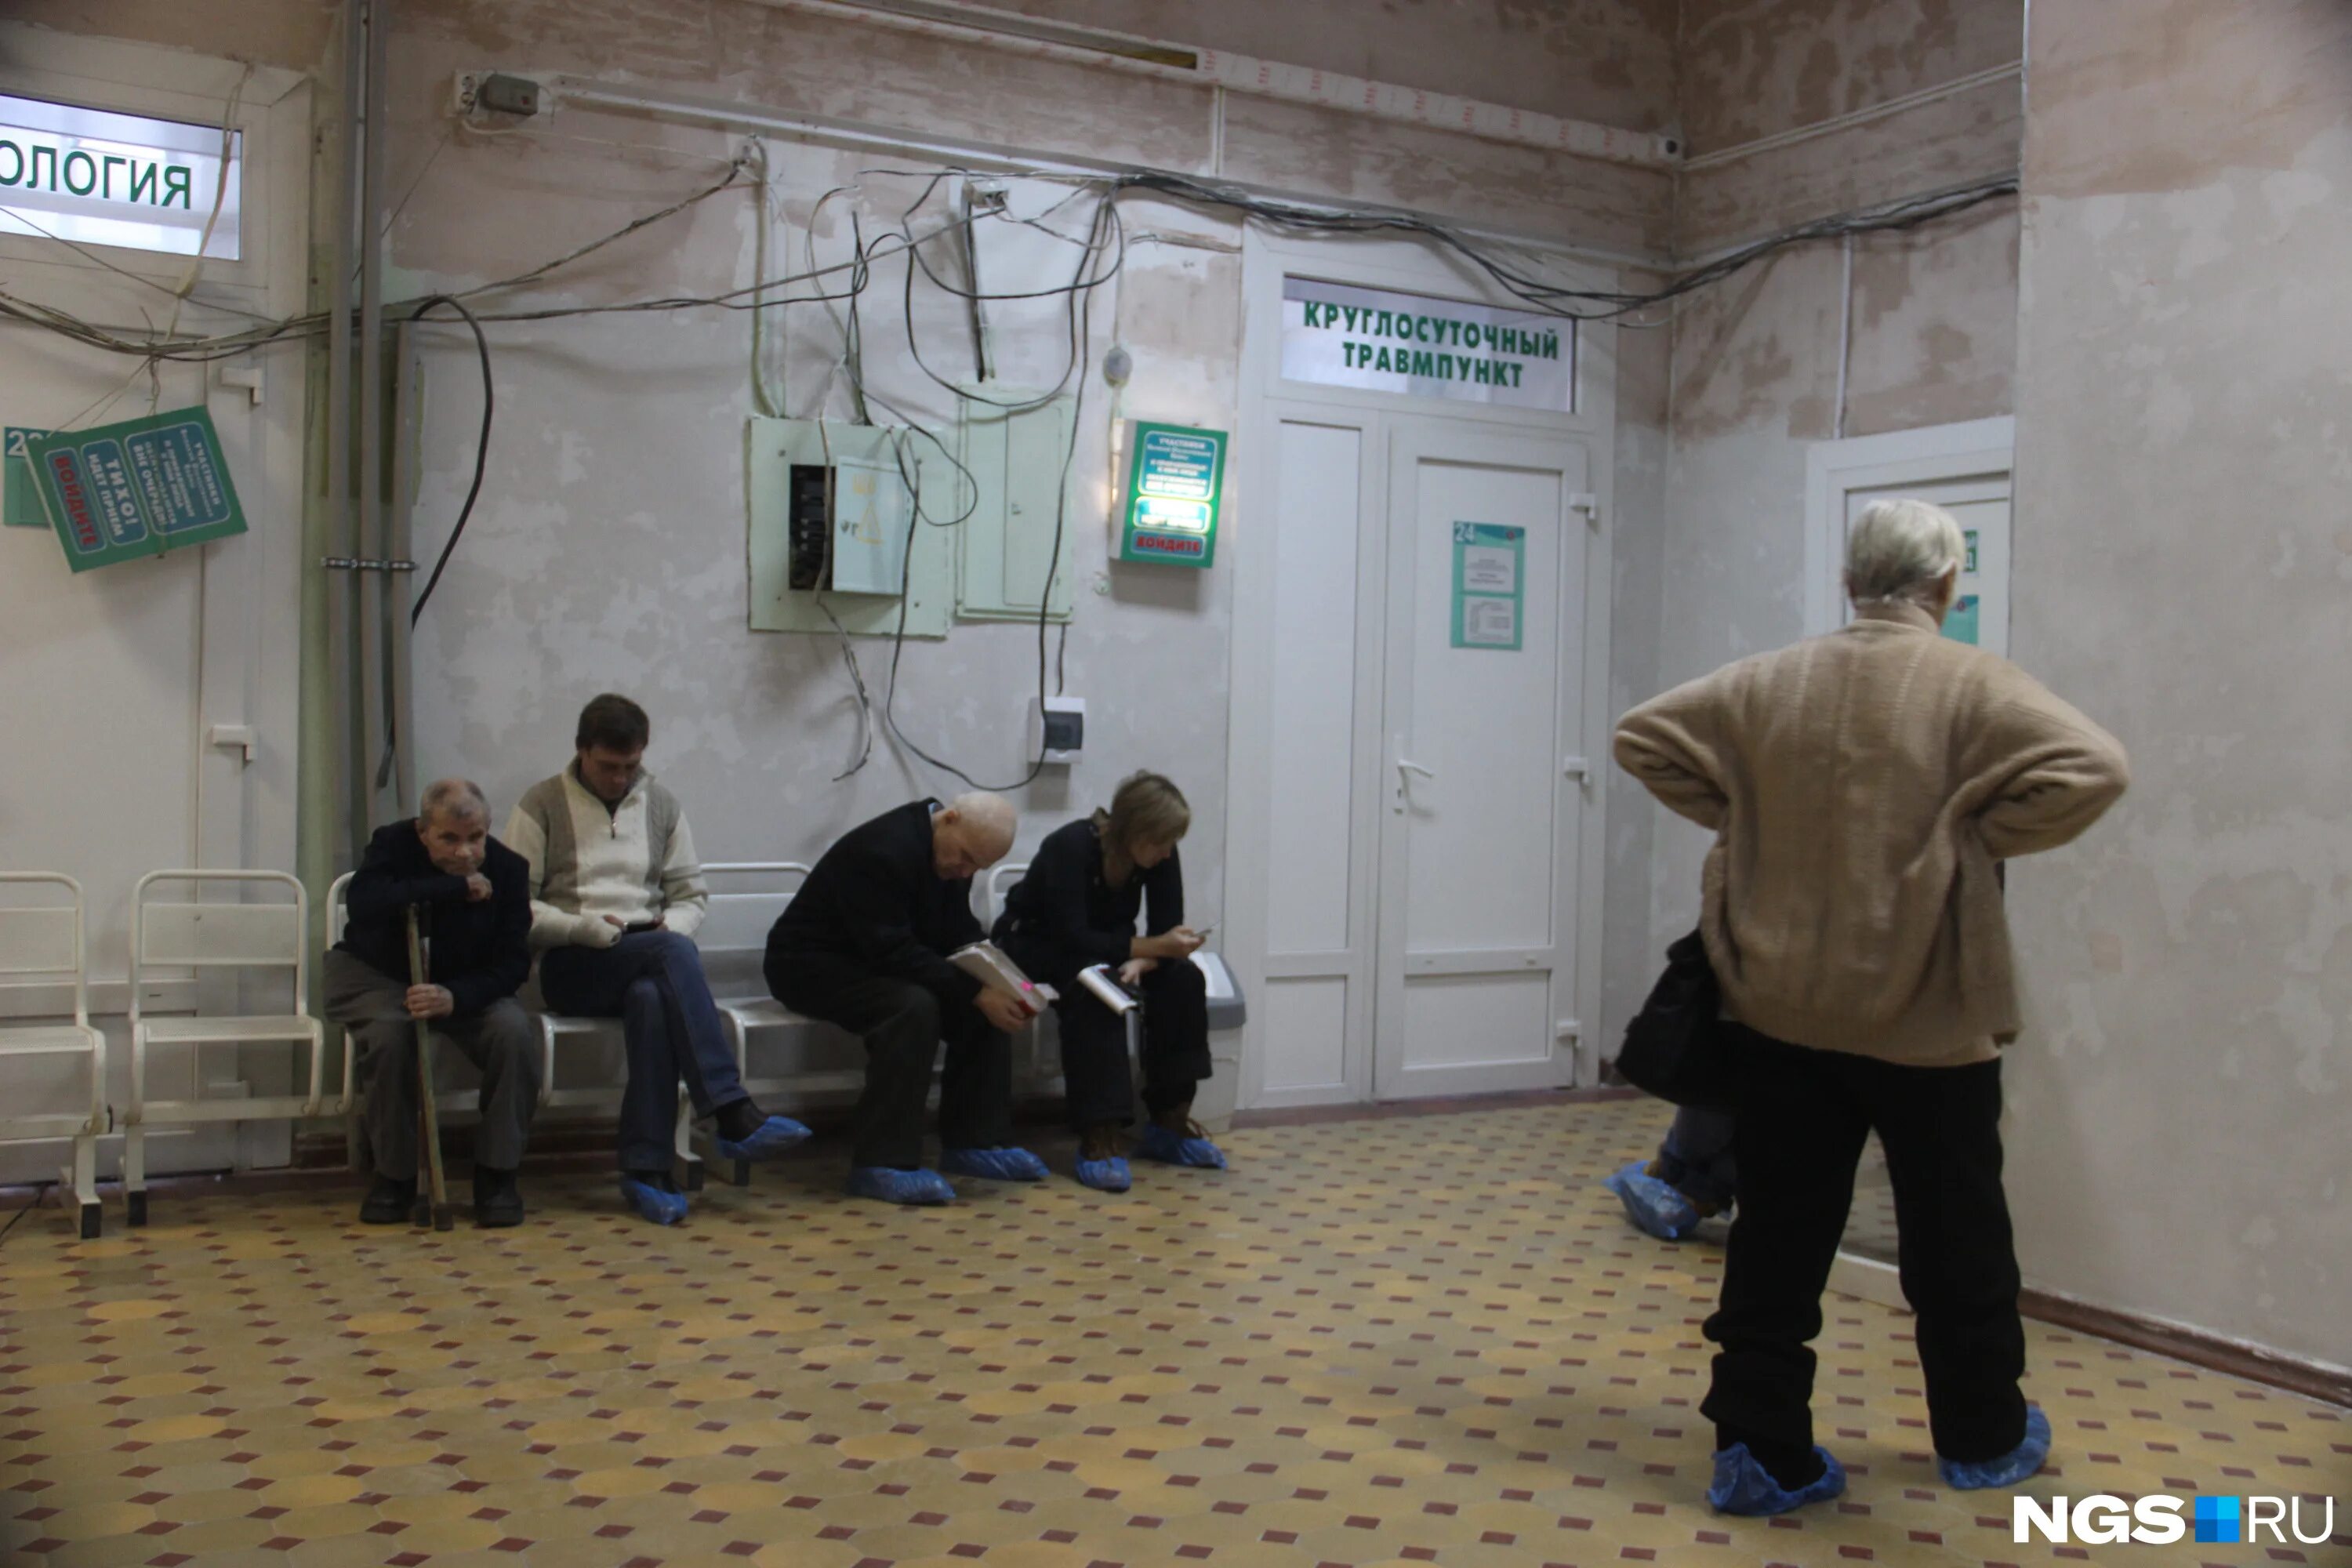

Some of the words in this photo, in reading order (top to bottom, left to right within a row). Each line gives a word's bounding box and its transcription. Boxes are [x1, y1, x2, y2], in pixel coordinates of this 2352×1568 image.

[0, 140, 191, 209] ОЛОГИЯ
[1303, 301, 1559, 360] КРУГЛОСУТОЧНЫЙ
[1341, 342, 1524, 387] ТРАВМПУНКТ
[53, 456, 99, 546] ВОЙДИТЕ
[85, 453, 108, 487] ИДЕТ
[98, 488, 125, 536] ПРИЕМ
[103, 459, 140, 525] ТИХО!
[1138, 536, 1200, 552] ВОЙДИТЕ
